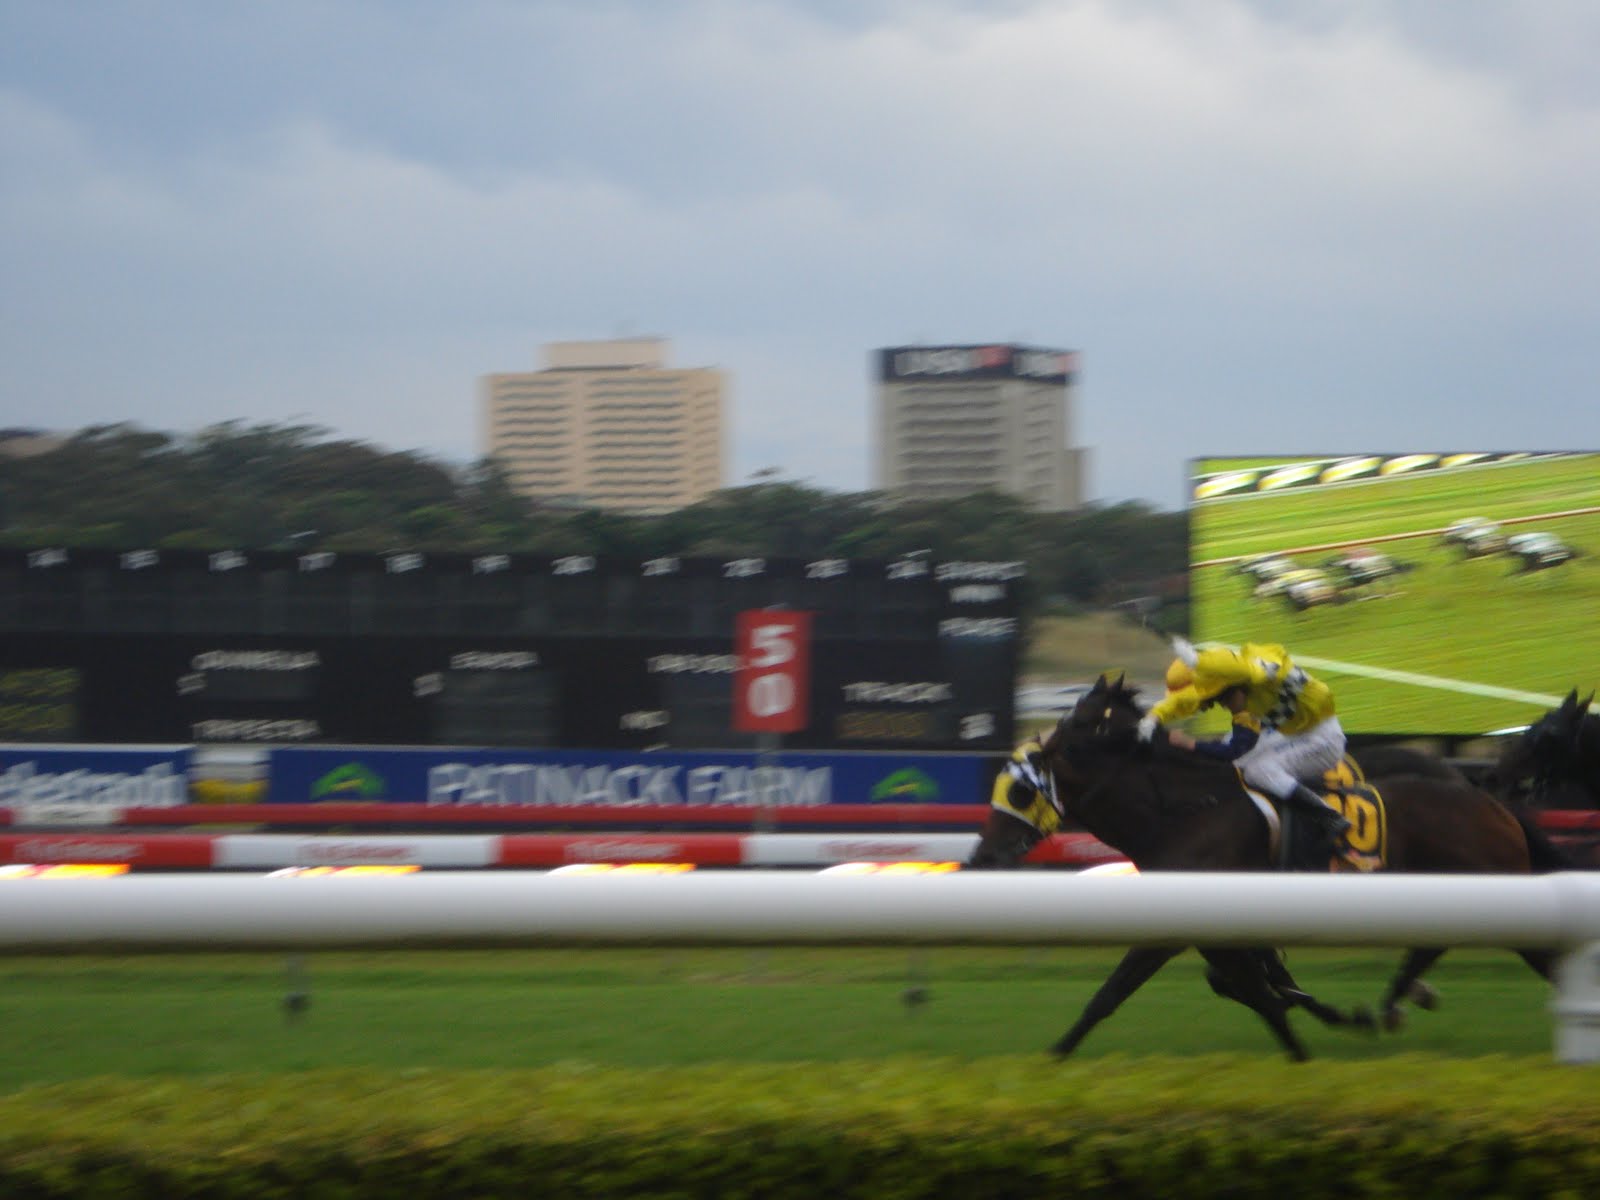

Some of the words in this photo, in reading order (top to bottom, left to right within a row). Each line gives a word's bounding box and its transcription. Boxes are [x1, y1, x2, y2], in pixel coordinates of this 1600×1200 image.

[752, 624, 796, 667] 5
[747, 673, 796, 717] 0
[687, 766, 832, 806] FARM
